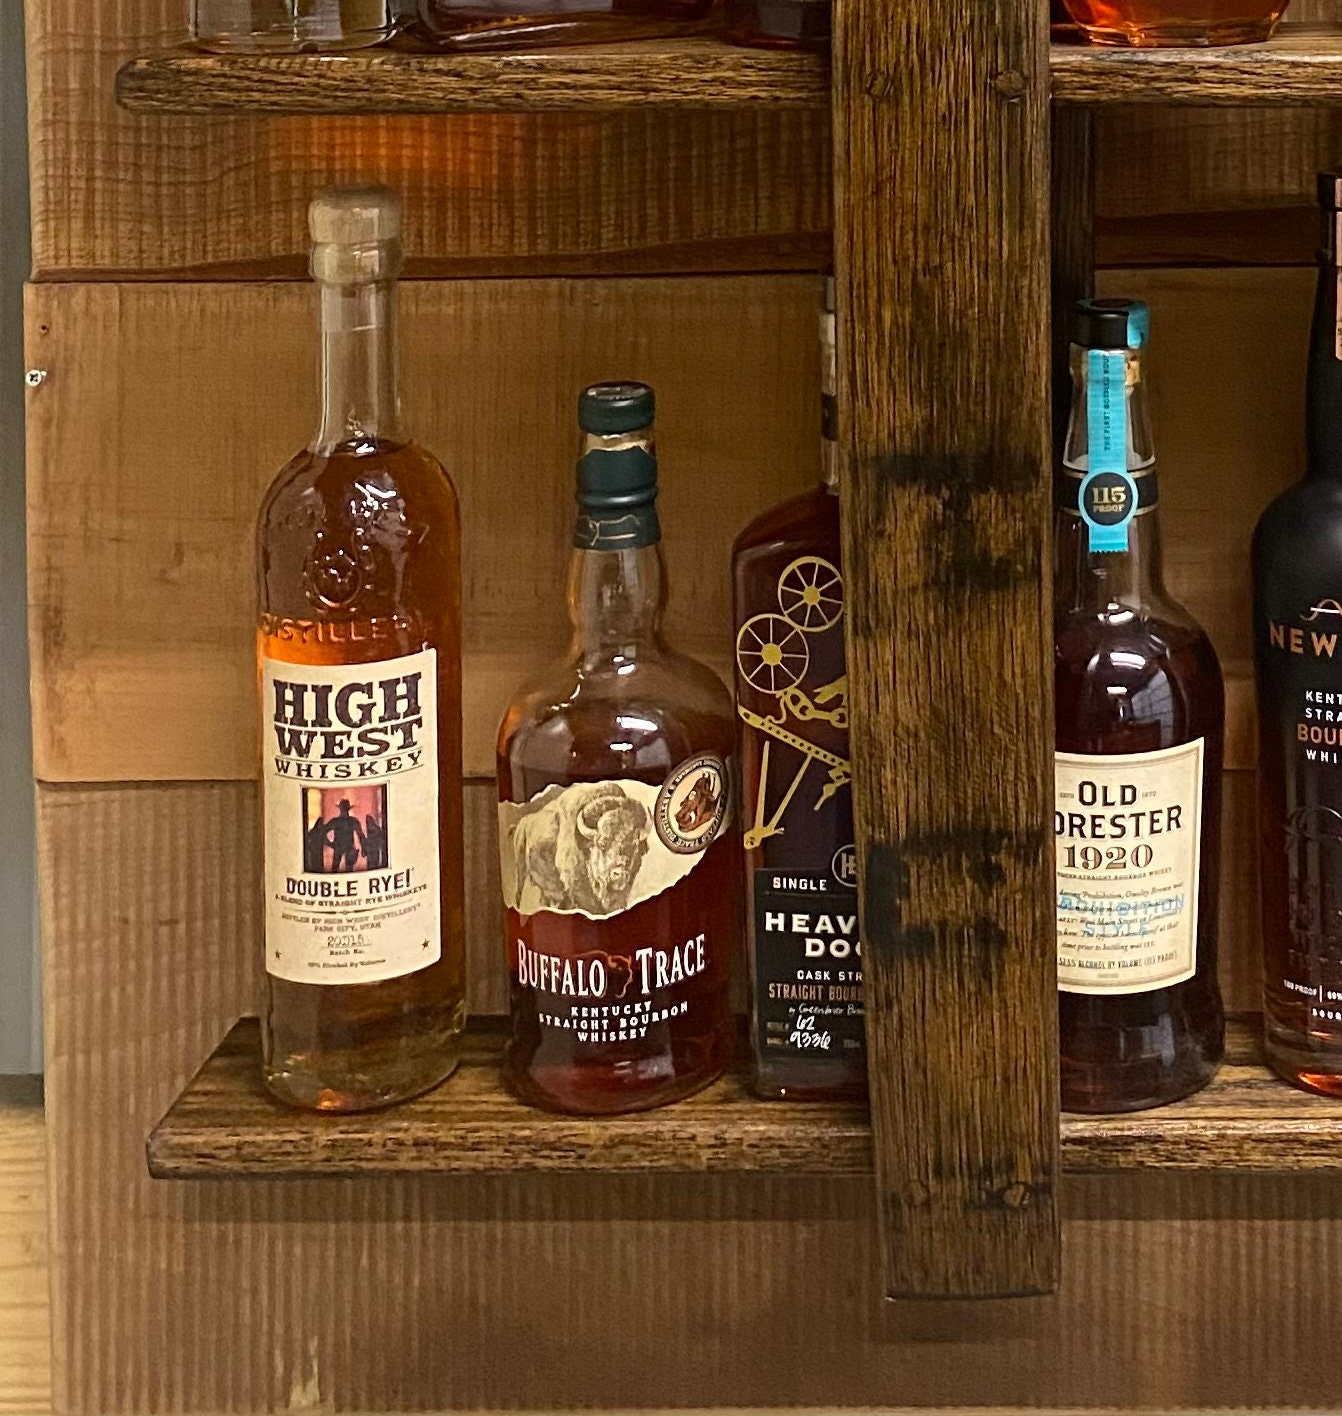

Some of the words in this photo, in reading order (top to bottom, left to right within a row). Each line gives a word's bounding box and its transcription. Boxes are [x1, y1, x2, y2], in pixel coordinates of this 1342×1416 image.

[1092, 486, 1126, 503] 115
[1269, 620, 1337, 658] NEW
[272, 671, 423, 728] HIGH
[274, 721, 424, 760] WEST
[274, 749, 424, 779] WHISKEY
[1078, 780, 1137, 807] OLD
[1055, 805, 1182, 839] ORESTER
[1063, 844, 1154, 870] 1920
[286, 877, 358, 898] DOUBLE
[369, 868, 411, 895] RYE!
[772, 877, 827, 891] SINGLE
[765, 912, 856, 935] HEAV
[516, 938, 606, 998] BUFFALO
[635, 934, 706, 995] TRACE
[539, 1012, 609, 1030] STRAIGHT
[619, 1001, 689, 1029] BOURBON
[570, 1000, 652, 1018] KENTUCKY
[577, 1027, 648, 1043] WHISKEY
